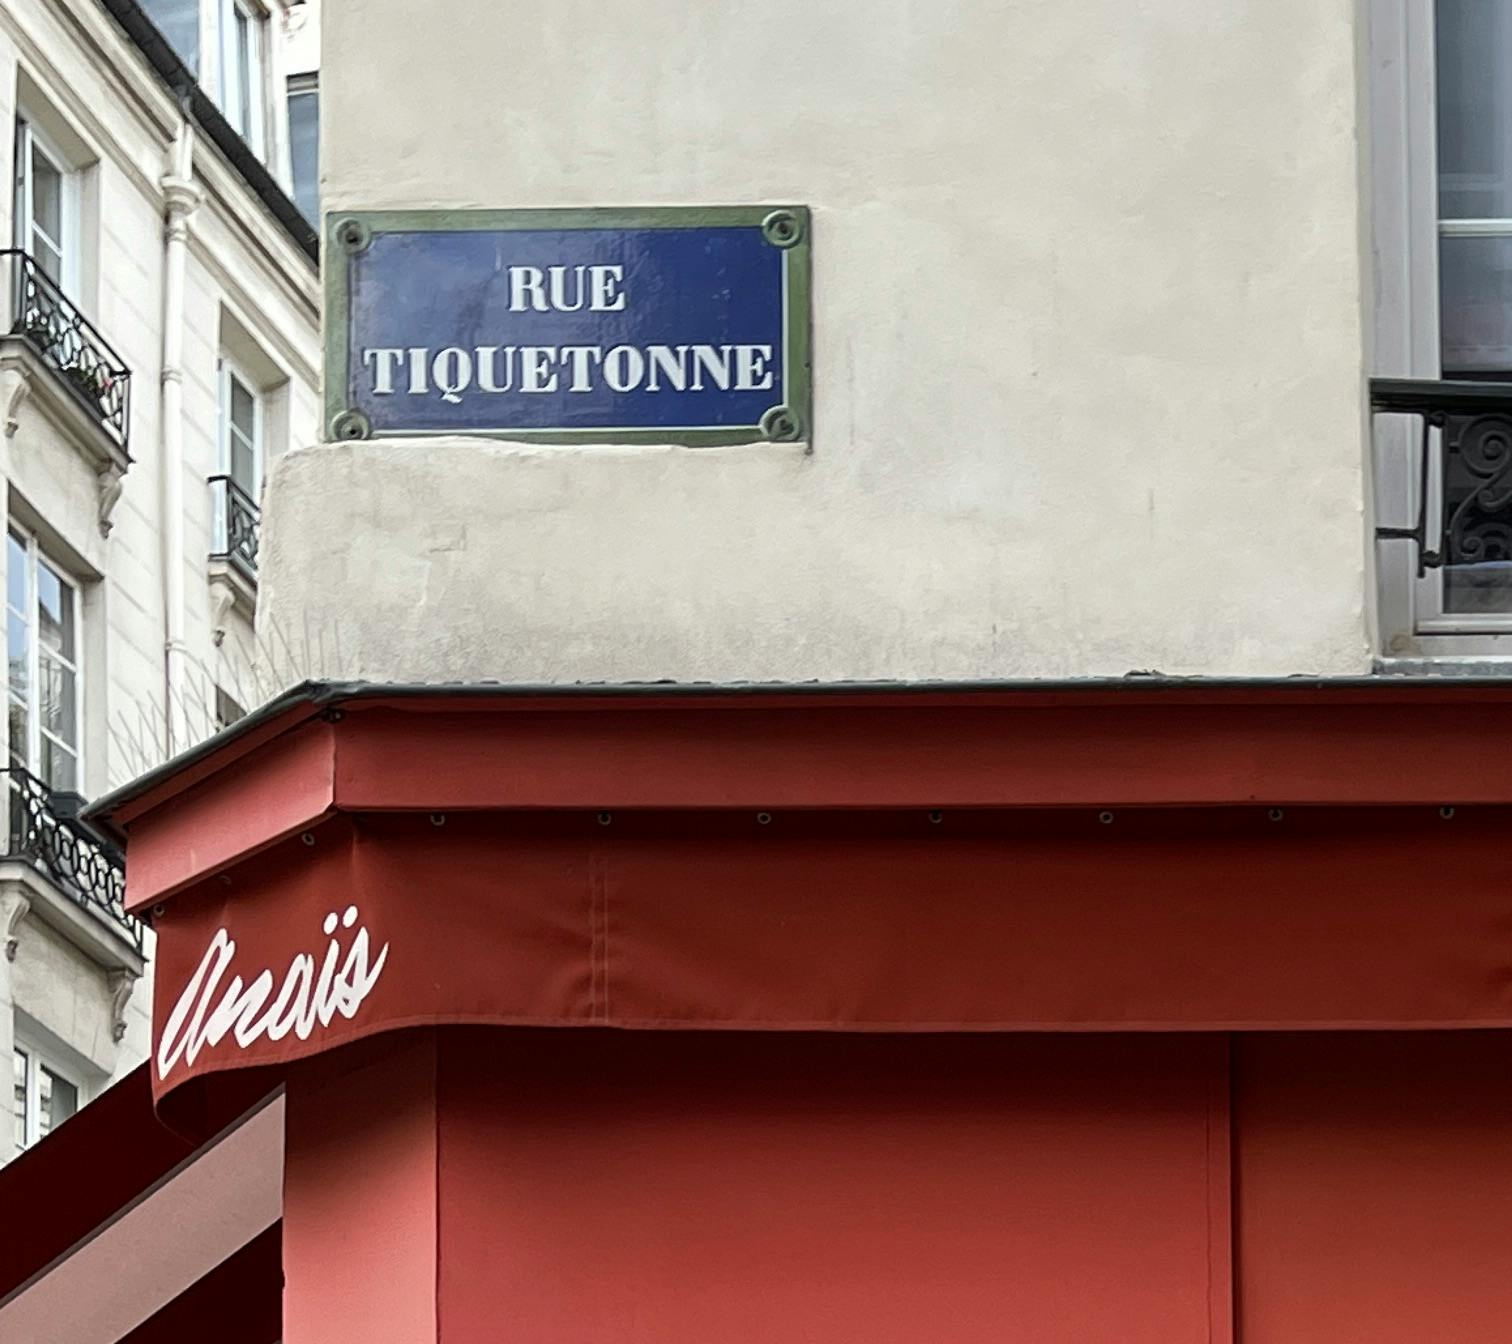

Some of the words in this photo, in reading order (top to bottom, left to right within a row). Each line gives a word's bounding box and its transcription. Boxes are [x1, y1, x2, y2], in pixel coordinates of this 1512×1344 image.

[509, 265, 625, 312] RUE
[363, 345, 773, 403] TIQUETONNE
[157, 905, 389, 1081] Anaïs
